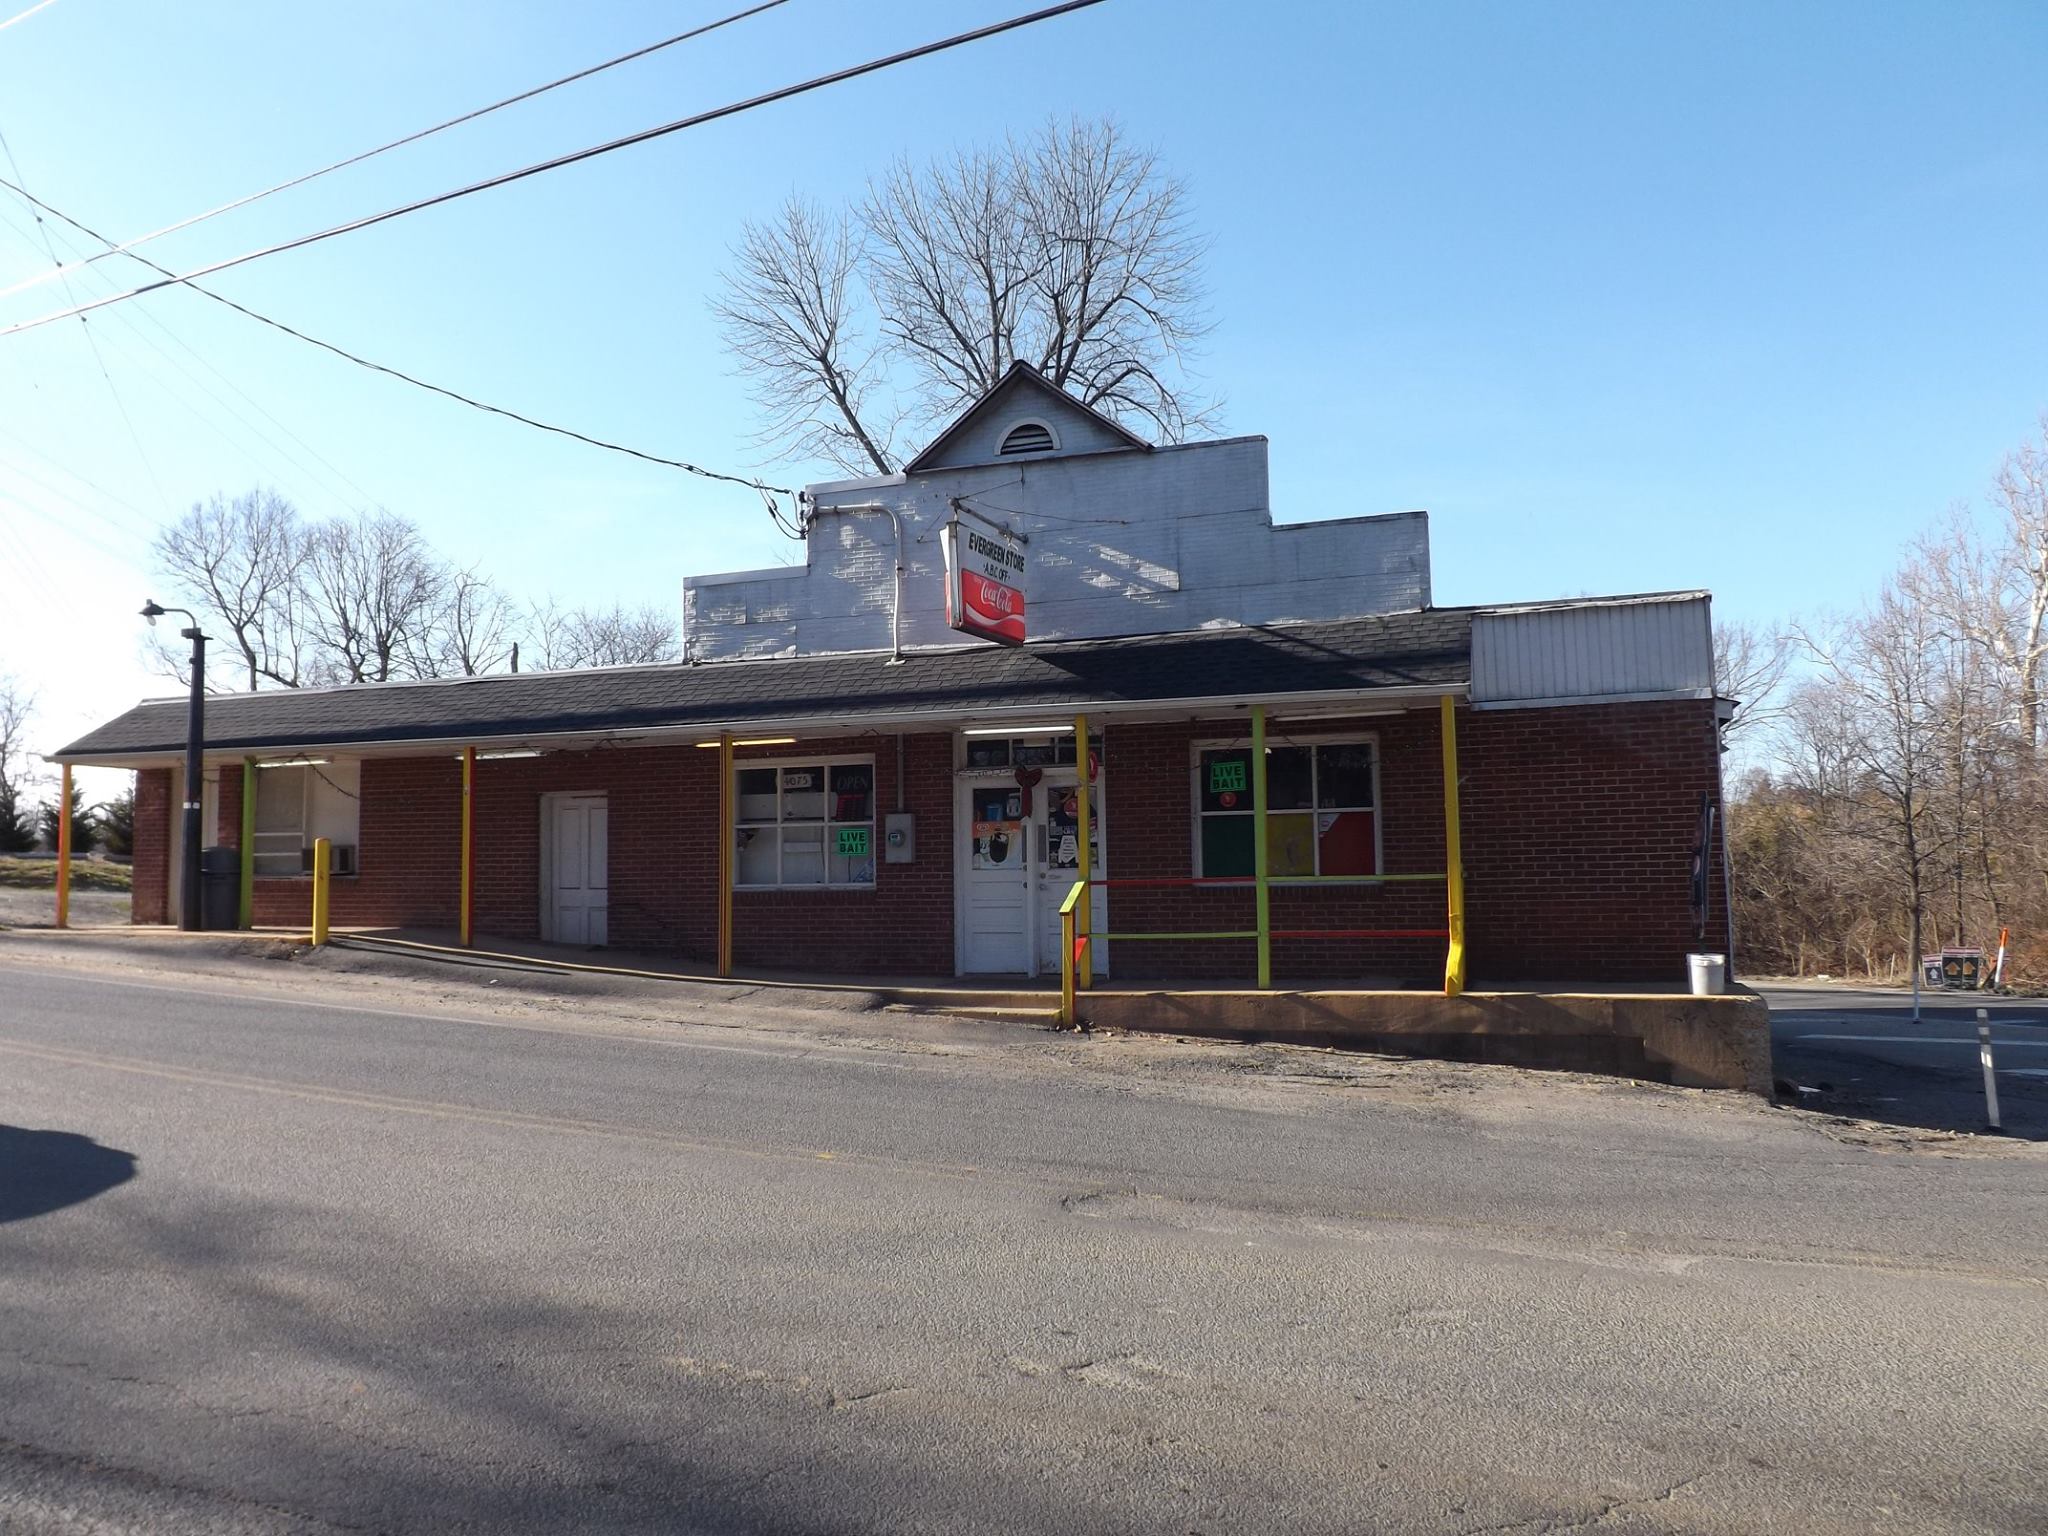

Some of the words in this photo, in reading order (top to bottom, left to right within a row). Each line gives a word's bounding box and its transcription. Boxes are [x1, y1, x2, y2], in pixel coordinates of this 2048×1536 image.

[969, 533, 1005, 563] EVERGREEN
[1005, 550, 1024, 573] STORE
[998, 568, 1009, 582] OFF
[1213, 766, 1241, 777] LIVE
[837, 775, 869, 790] OPEN
[1213, 777, 1242, 788] BAIT
[840, 832, 865, 842] LIVE
[840, 843, 866, 853] BAIT
